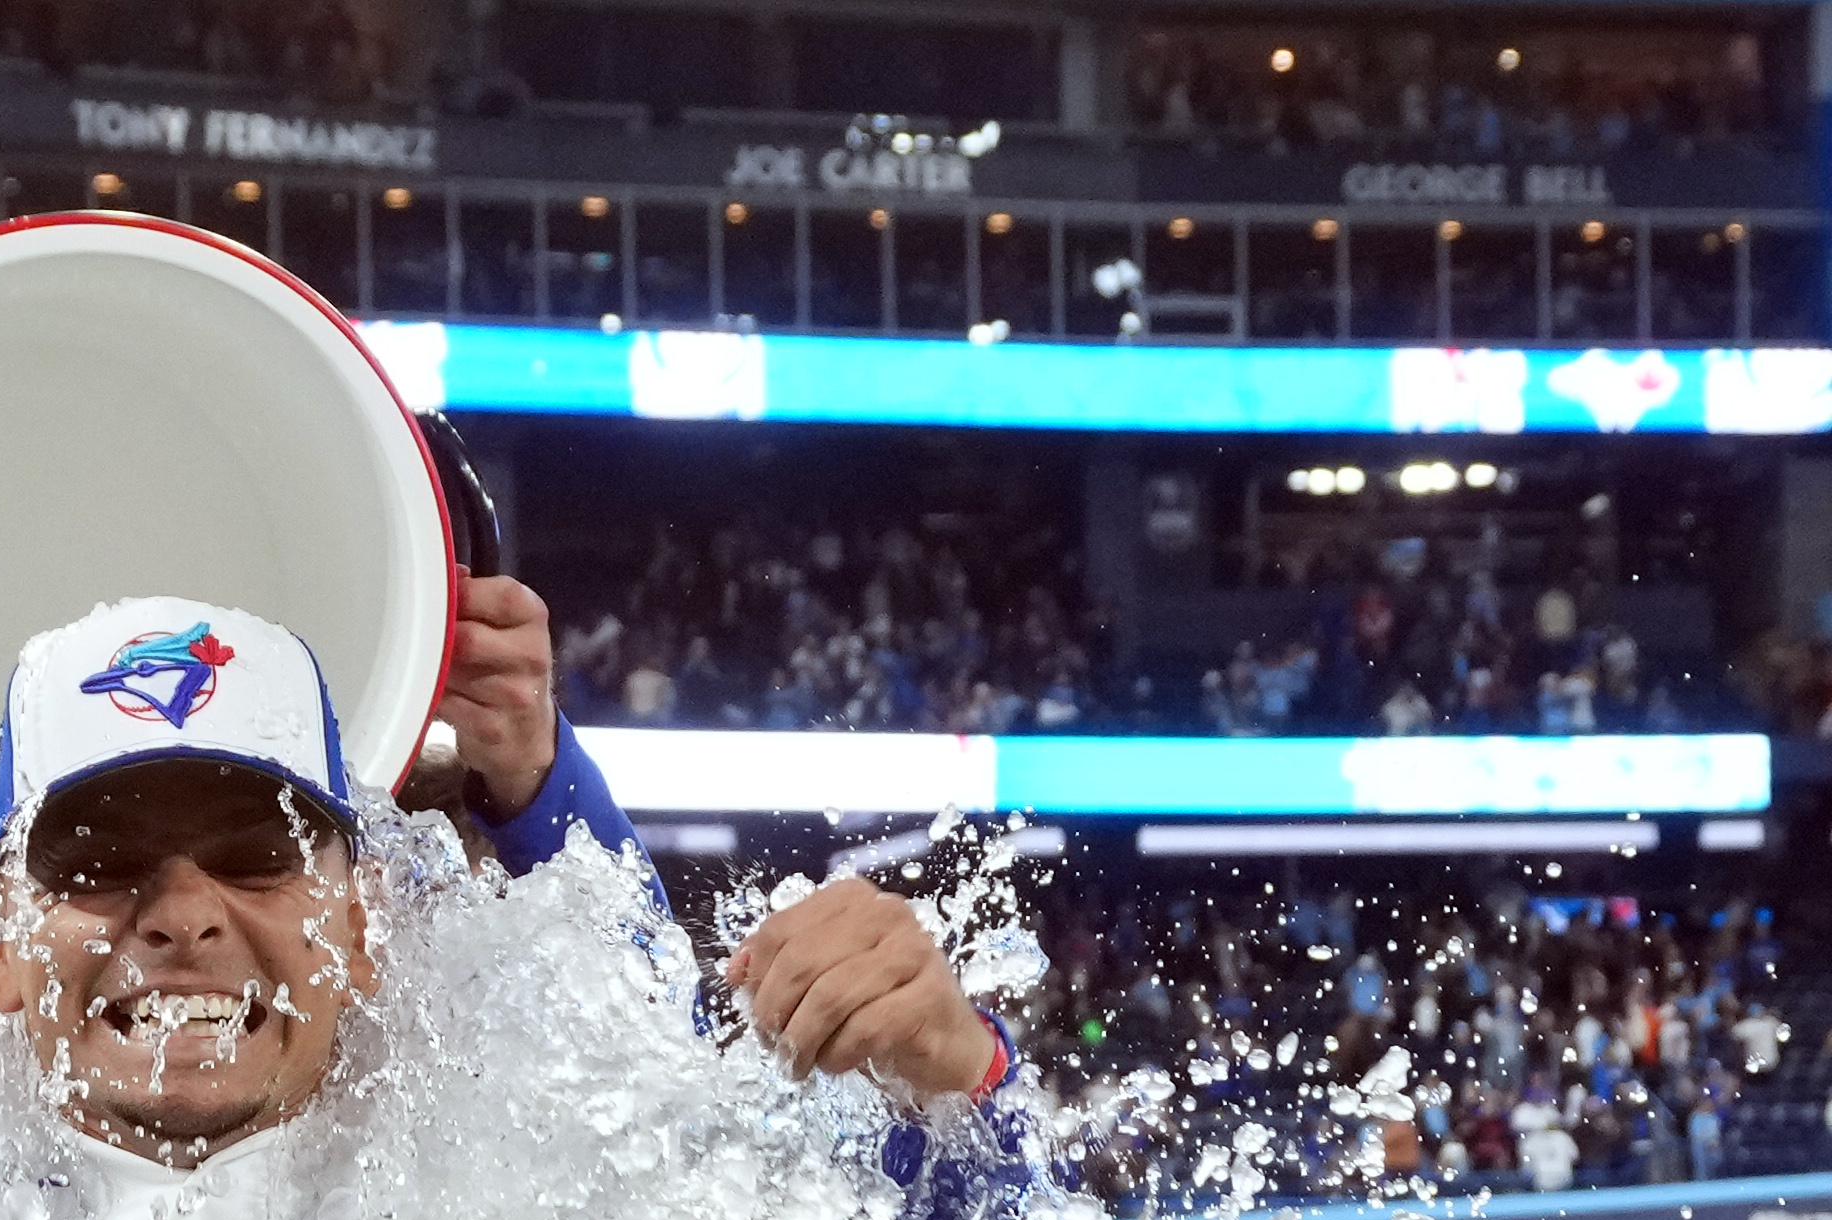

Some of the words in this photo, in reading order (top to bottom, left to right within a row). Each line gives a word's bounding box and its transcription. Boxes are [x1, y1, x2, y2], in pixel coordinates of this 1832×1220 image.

[71, 98, 191, 154] TONY
[203, 109, 437, 171] FERNANDEZ
[725, 143, 805, 189] JOE
[818, 147, 972, 192] CARTER
[1342, 162, 1508, 202] GEORGE
[1522, 164, 1613, 203] BELL
